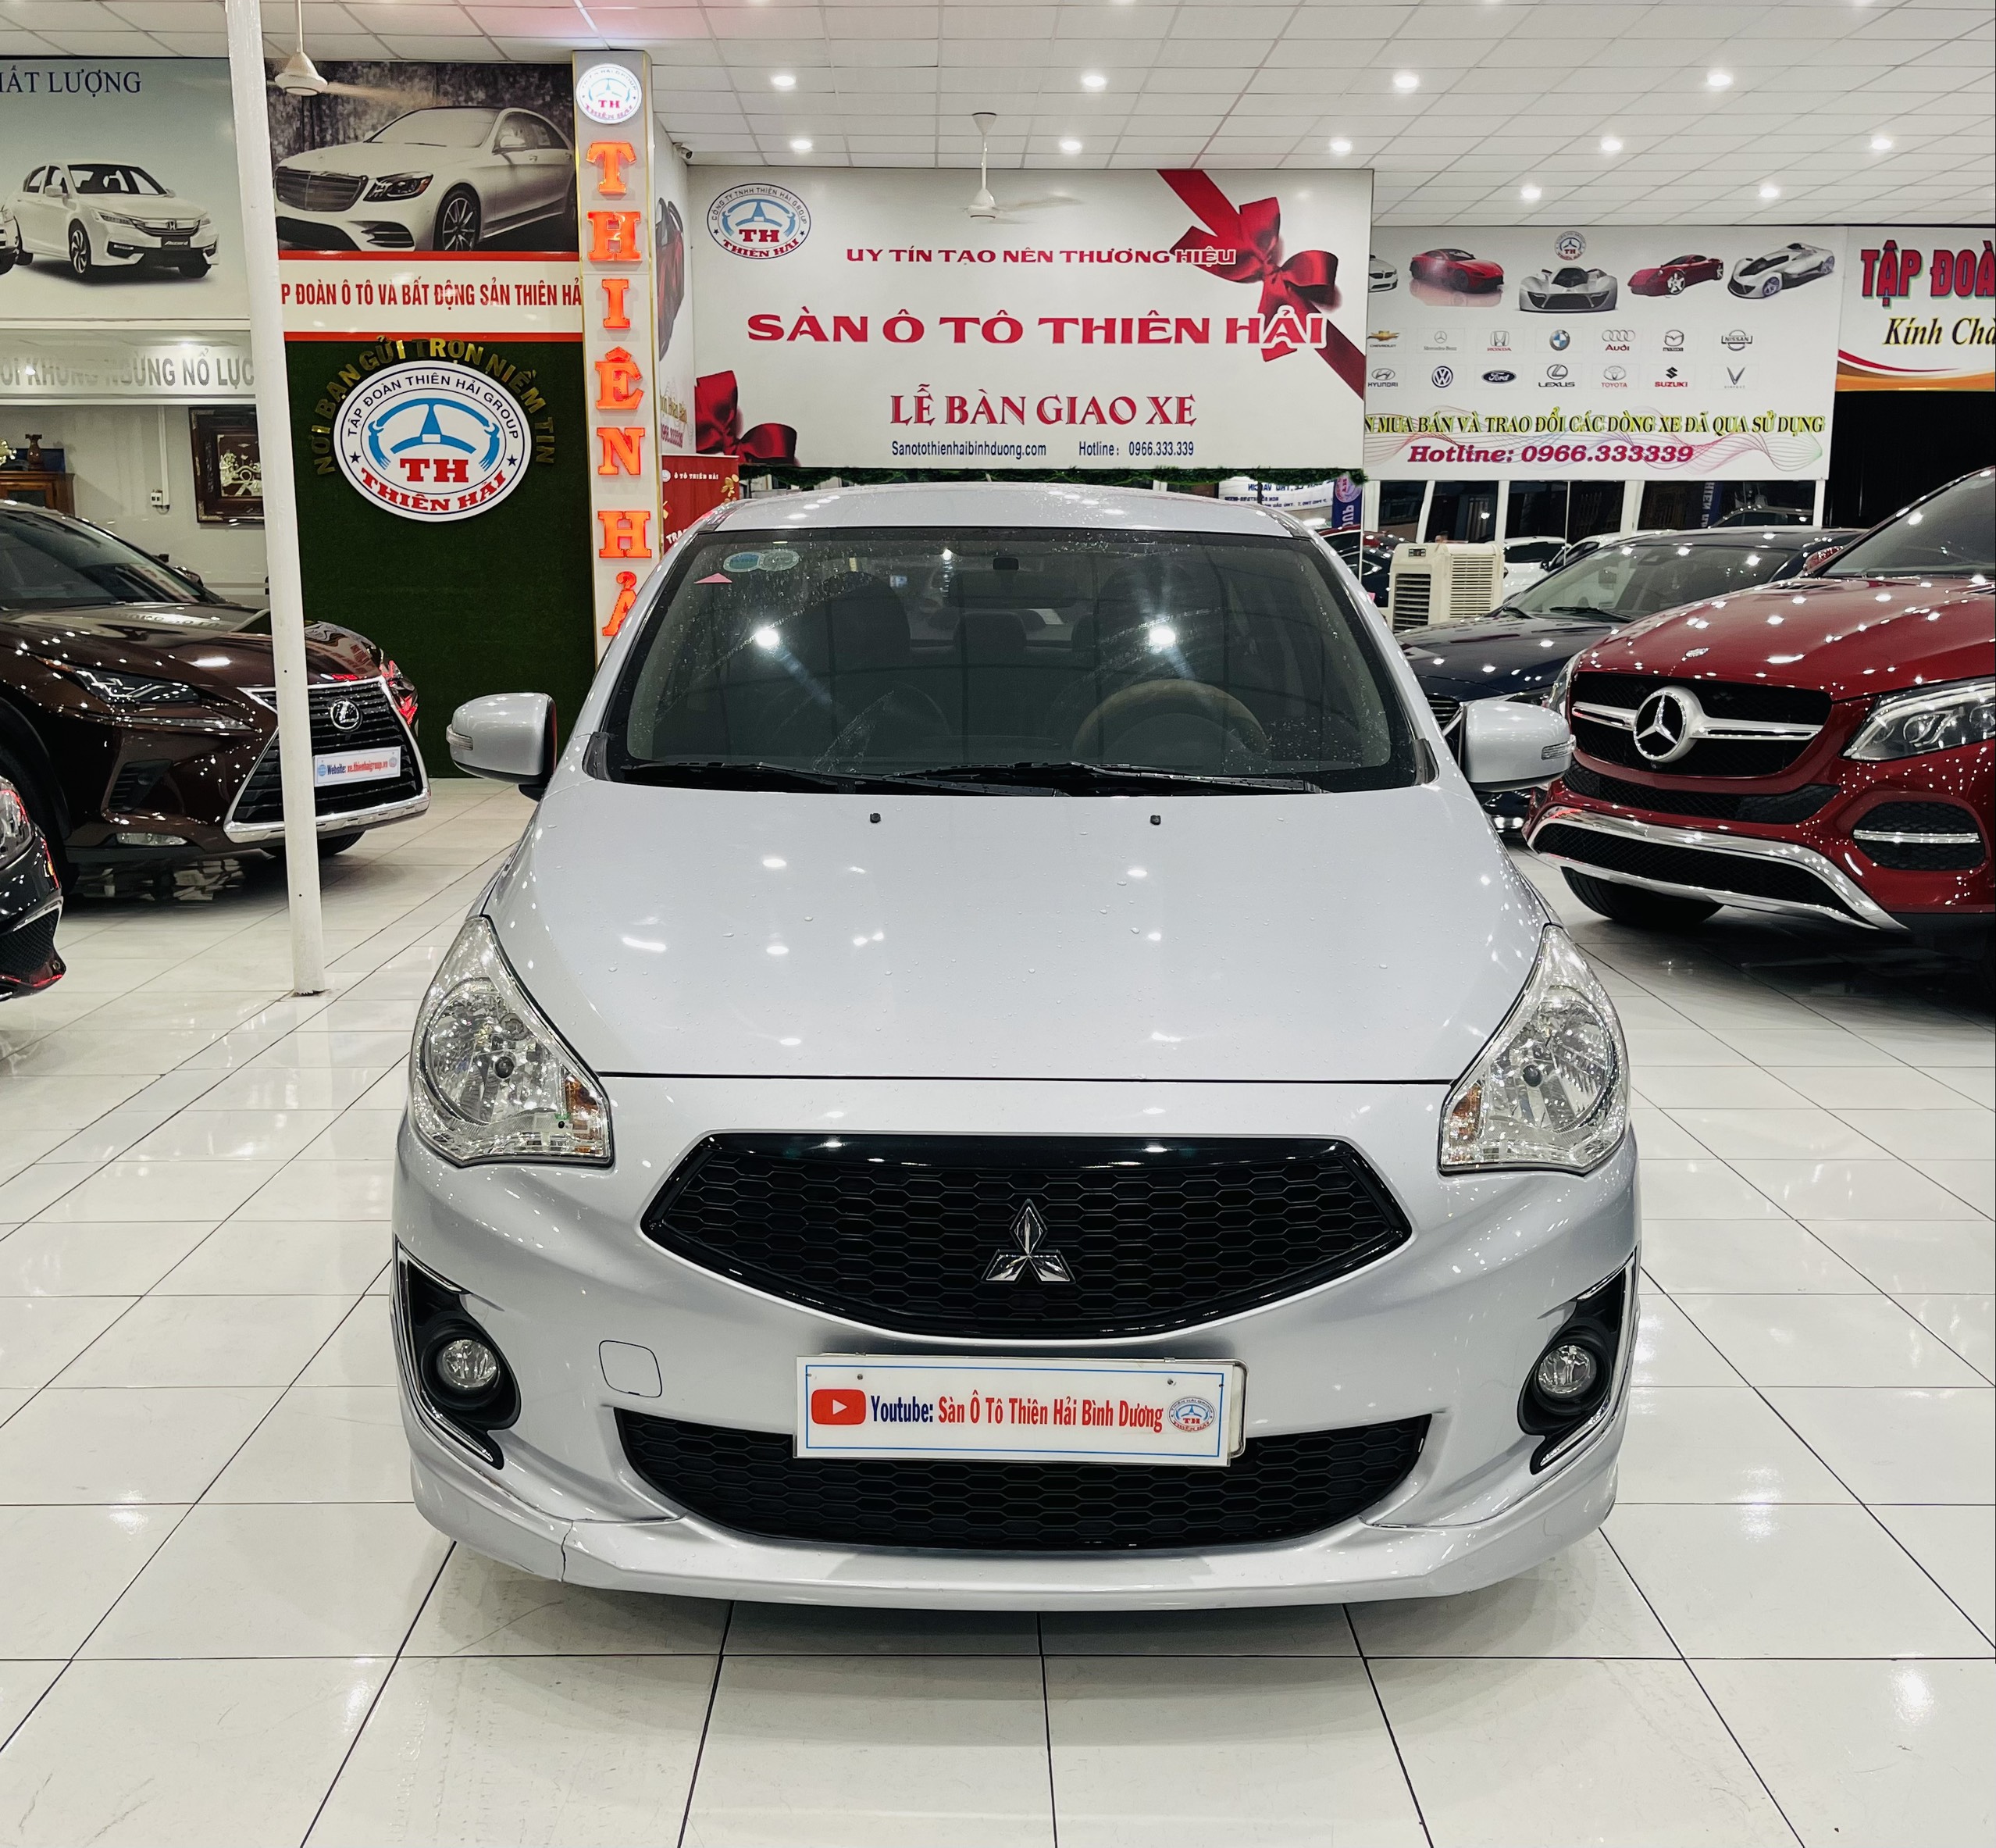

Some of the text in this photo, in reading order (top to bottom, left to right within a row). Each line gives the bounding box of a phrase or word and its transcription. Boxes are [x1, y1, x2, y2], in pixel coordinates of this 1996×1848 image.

[48, 69, 141, 98] LƯỢNG
[598, 100, 620, 109] TH
[711, 200, 725, 220] CÔNG
[734, 188, 754, 197] TNHH
[792, 200, 807, 224] GROUP
[723, 238, 770, 257] THIÊN
[739, 229, 779, 242] TH
[847, 248, 883, 262] UY
[889, 245, 932, 262] TÍN
[1003, 246, 1053, 262] NÊN
[1060, 248, 1171, 263] THƯƠNG
[1176, 246, 1236, 266] HIỆU
[1861, 240, 1922, 307] TẬP
[296, 278, 336, 305] ĐOÀN
[342, 280, 351, 305] Ô
[355, 279, 374, 305] TÔ
[378, 279, 397, 305] VÀ
[402, 276, 429, 305] BẤT
[434, 279, 475, 310] ĐỘNG
[480, 276, 510, 305] SẢN
[515, 280, 558, 305] THIÊN
[747, 306, 1323, 344] SÀN Ô TÔ THIÊN HẢI
[1883, 317, 1942, 345] Kính
[216, 355, 255, 389] LỰC
[1488, 372, 1510, 381] Ford
[312, 335, 555, 475] NƠI BẠN GỬI TRỌN NIỀM TIN
[348, 372, 519, 439] TẬP ĐOÀN THIÊN HẢI GROUP
[890, 384, 1197, 426] LỄ BÀN GIAO XE
[1378, 416, 1414, 433] MUA
[1418, 410, 1453, 433] BÁN
[1457, 410, 1483, 433] VÀ
[1485, 416, 1532, 433] TRAO
[1534, 406, 1565, 433] ĐỔI
[1569, 410, 1607, 433] CÁC
[1608, 410, 1655, 432] DÒNG
[1659, 416, 1681, 432] XE
[1684, 412, 1709, 432] ĐÃ
[1713, 416, 1748, 436] QUA
[1752, 410, 1775, 432] SỬ
[1777, 416, 1825, 437] DỤNG
[892, 441, 1194, 459] Sanotothienhaibinhduong.com Hotline: 0966.333.339
[1407, 444, 1693, 462] Hotline: 0966.333339
[400, 458, 469, 483] TH
[361, 467, 506, 512] THIÊN HẢI
[327, 763, 346, 775] Website:
[871, 1390, 1164, 1433] Youtube: Sàn Ô Tô Thiên Hải Bình Dương
